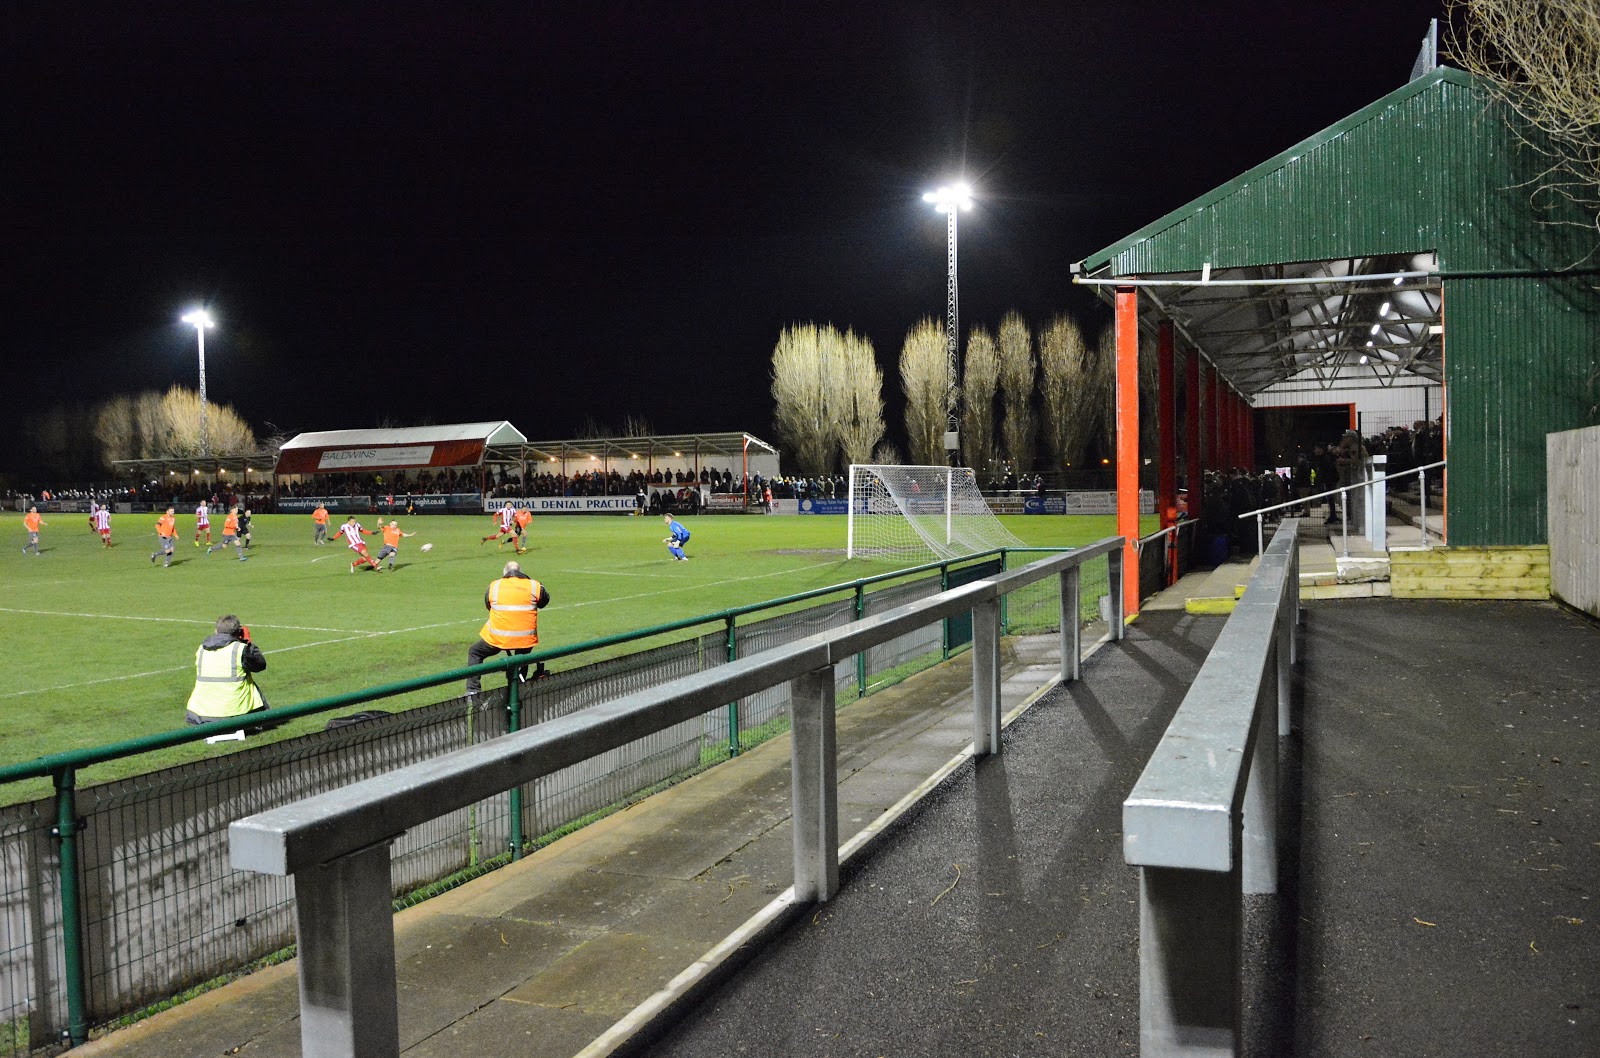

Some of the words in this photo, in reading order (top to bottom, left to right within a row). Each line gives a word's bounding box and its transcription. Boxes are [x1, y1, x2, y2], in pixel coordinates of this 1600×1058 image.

[322, 450, 377, 460] BALDWINS
[278, 499, 338, 508] www.andyfreighco.uk
[378, 497, 446, 507] ww.andeight.co.uk
[541, 500, 581, 509] DENTAL
[587, 499, 638, 508] PRACTICE
